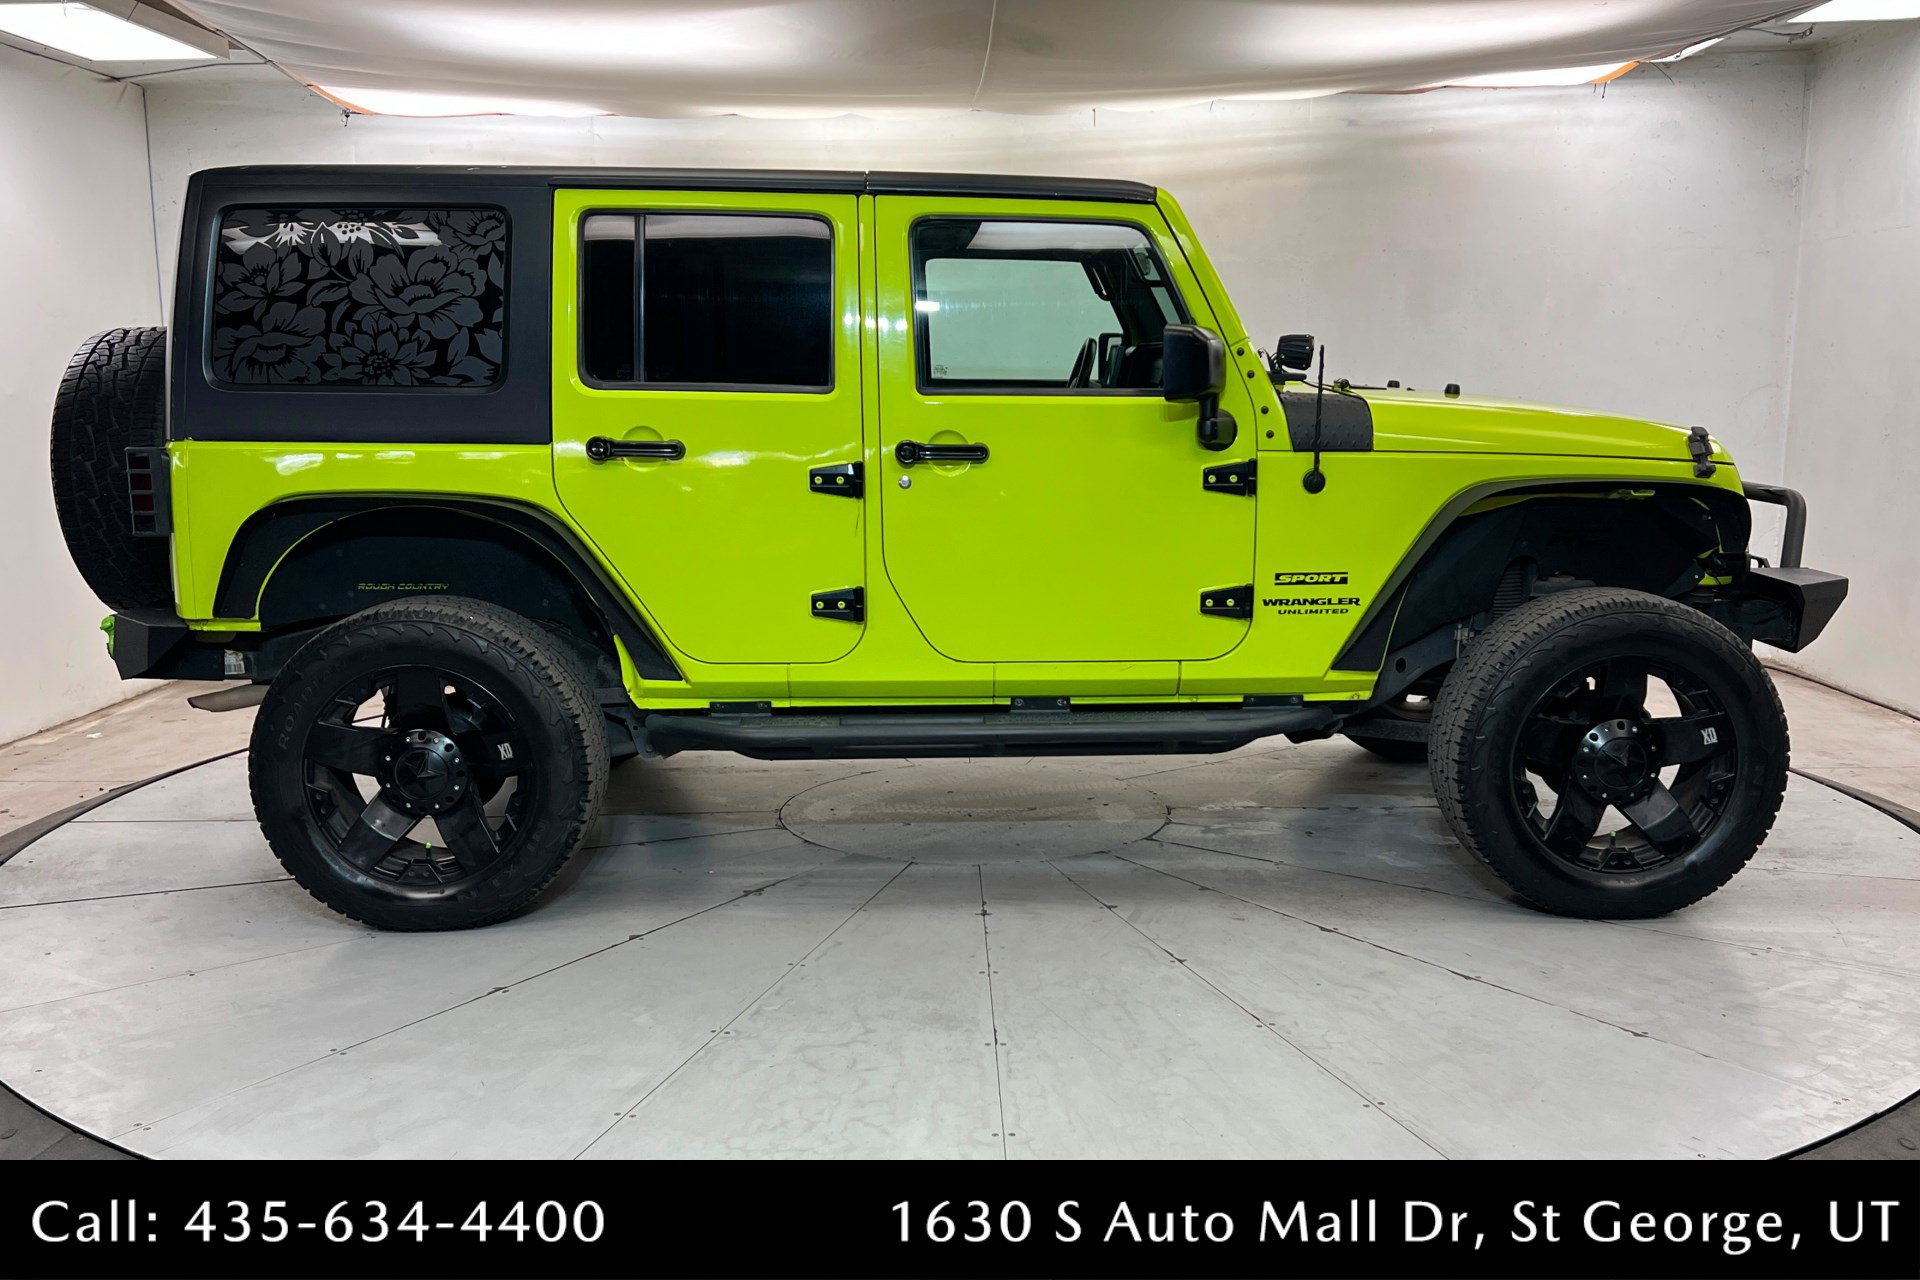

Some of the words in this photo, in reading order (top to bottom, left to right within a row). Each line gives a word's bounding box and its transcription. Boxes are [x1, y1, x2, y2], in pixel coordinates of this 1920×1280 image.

[1278, 573, 1348, 583] SPORT
[1262, 597, 1361, 607] WRANGLER
[497, 742, 514, 760] XD
